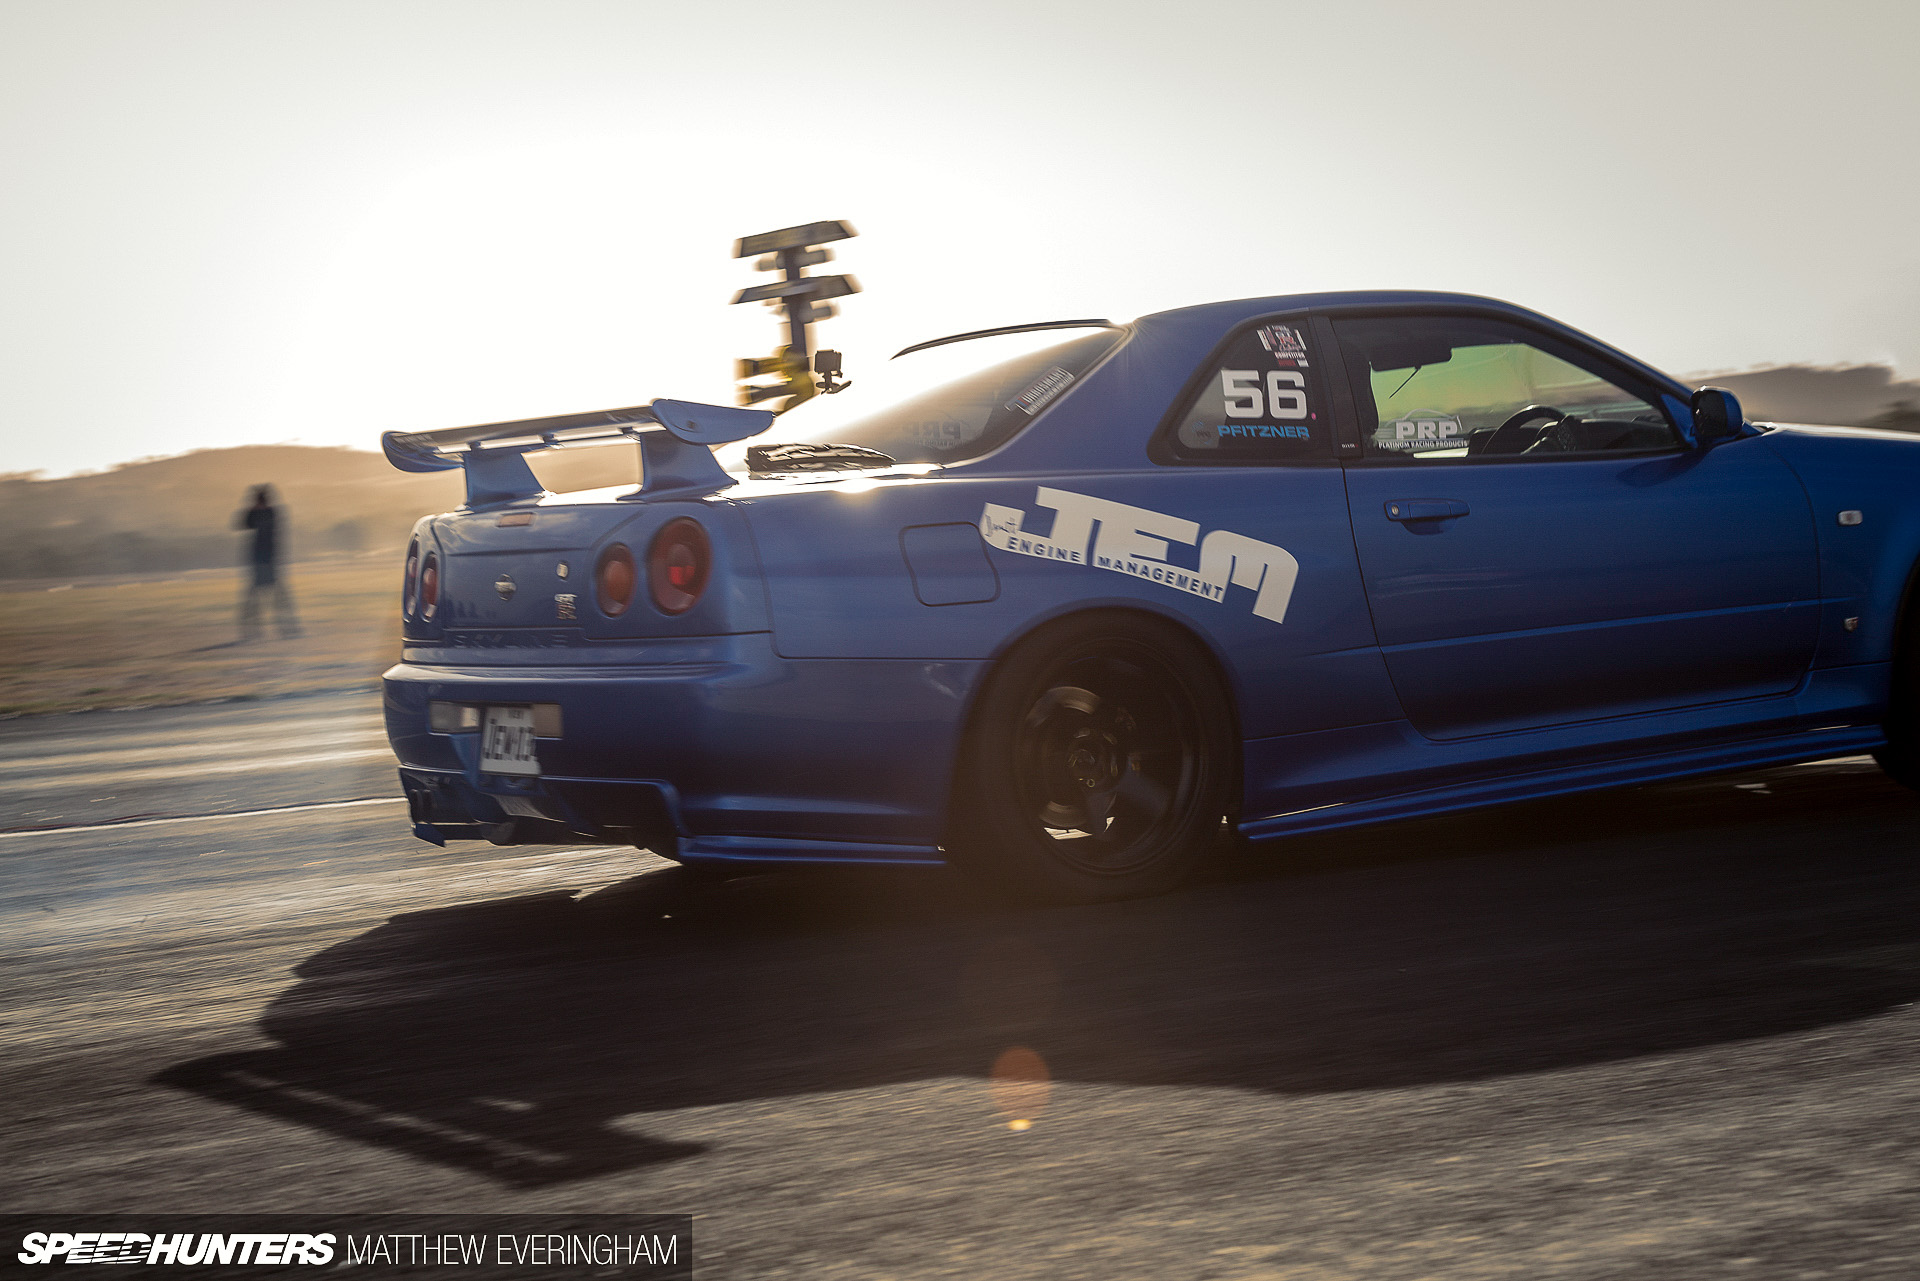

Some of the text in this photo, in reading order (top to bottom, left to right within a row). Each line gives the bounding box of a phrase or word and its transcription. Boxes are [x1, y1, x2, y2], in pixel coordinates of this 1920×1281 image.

[1220, 369, 1308, 420] 56
[1216, 424, 1311, 439] PFITZNER
[1395, 421, 1458, 440] PRP
[1378, 439, 1468, 449] PLATINUM RACING PRODUCTS
[1005, 536, 1224, 601] ENGINE MANAGEMENT
